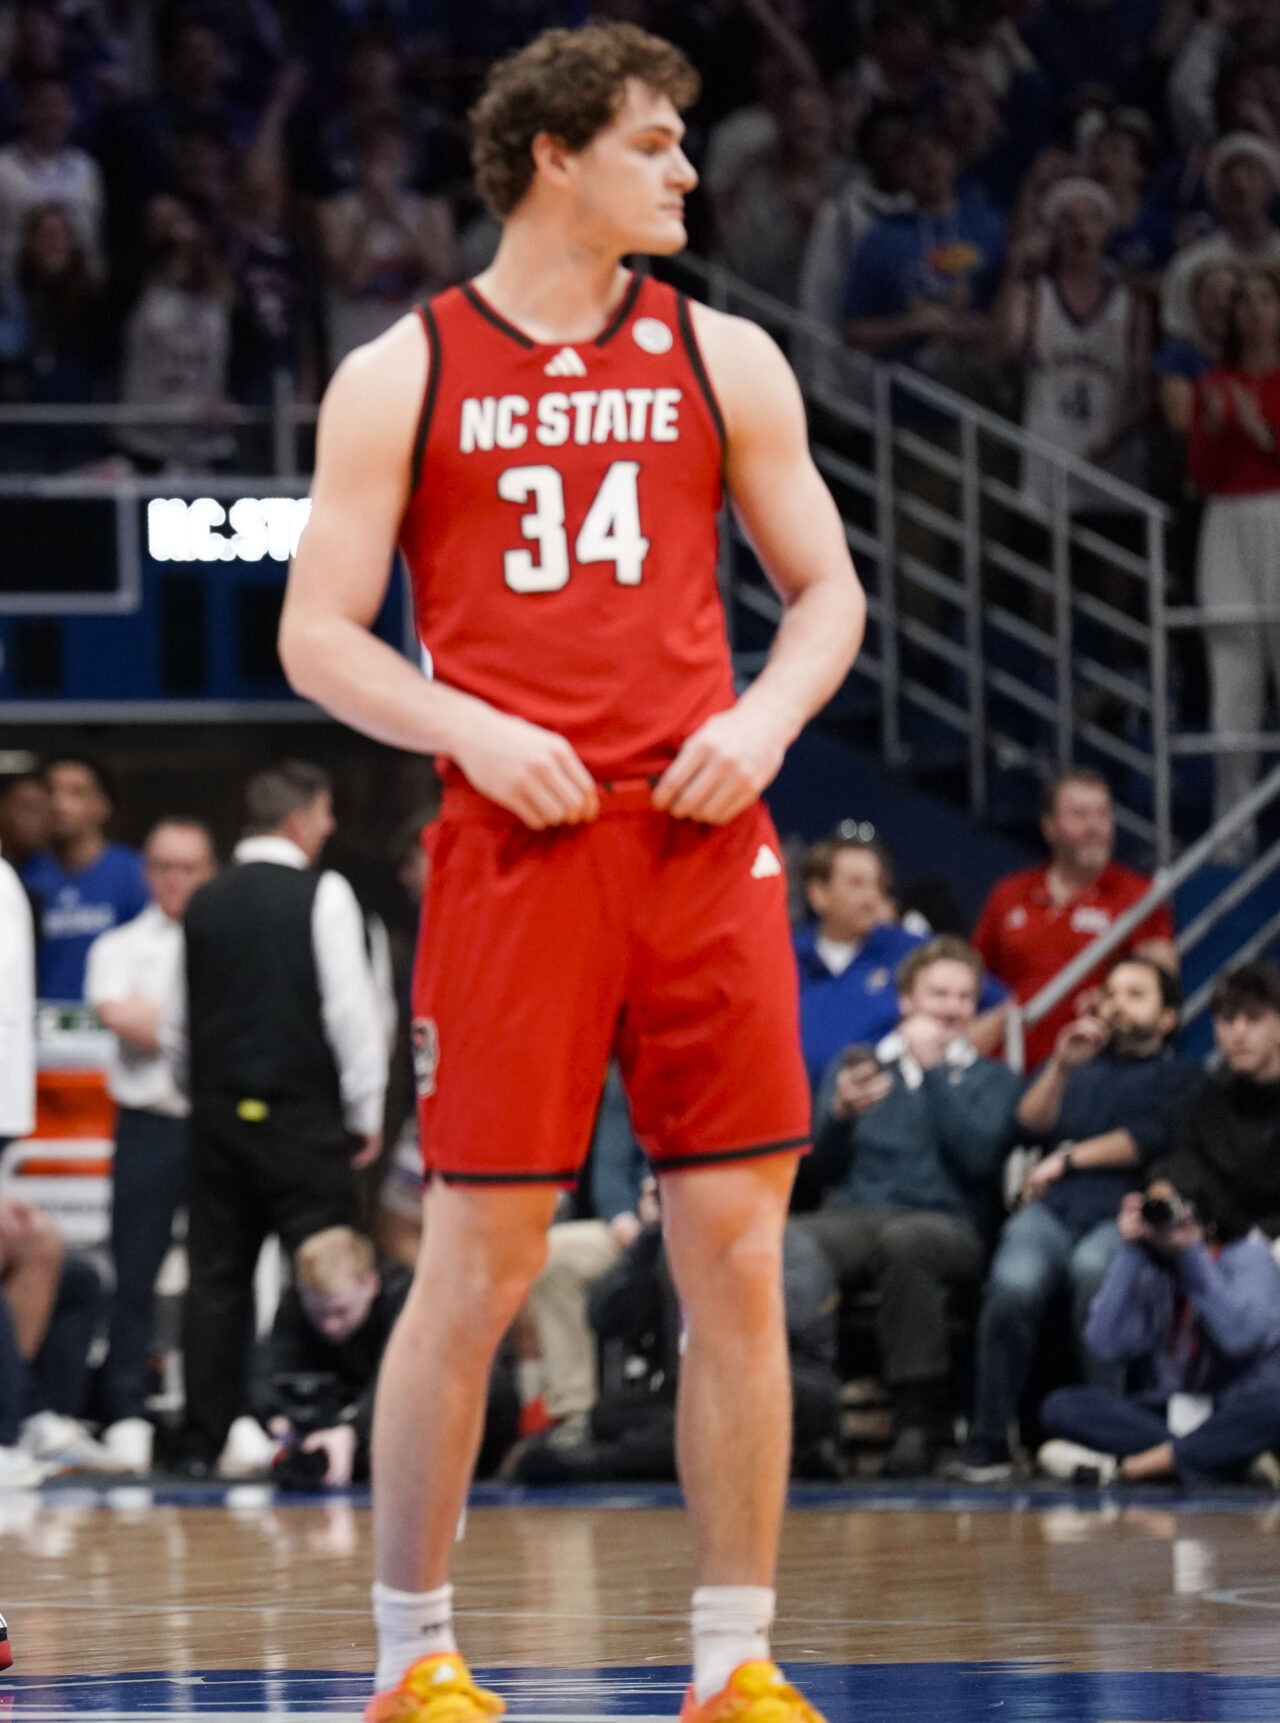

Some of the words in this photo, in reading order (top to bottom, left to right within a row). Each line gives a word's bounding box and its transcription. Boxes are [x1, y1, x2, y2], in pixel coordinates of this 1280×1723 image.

[459, 394, 530, 454] NC
[536, 388, 682, 446] STATE
[497, 460, 650, 595] 34
